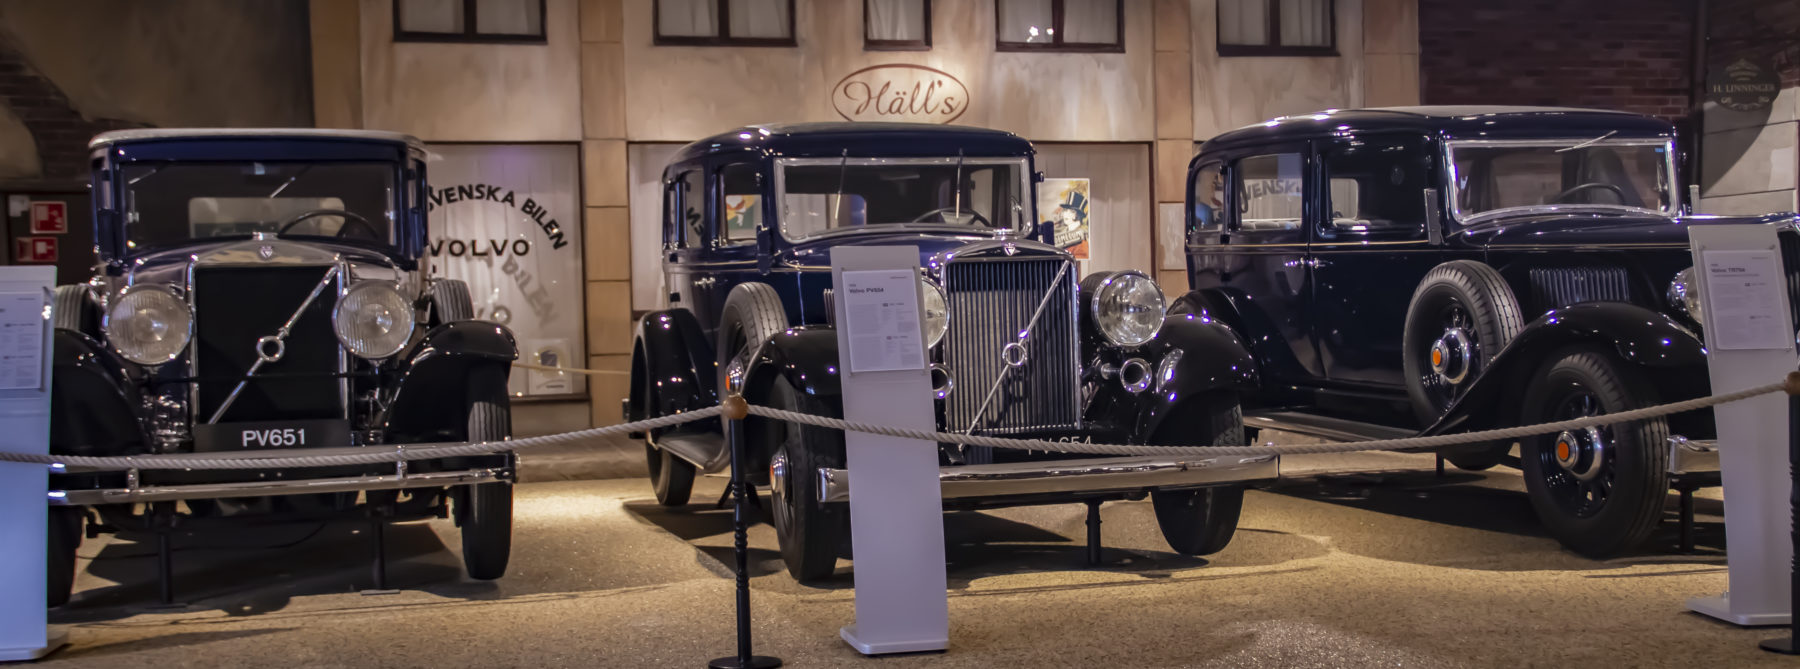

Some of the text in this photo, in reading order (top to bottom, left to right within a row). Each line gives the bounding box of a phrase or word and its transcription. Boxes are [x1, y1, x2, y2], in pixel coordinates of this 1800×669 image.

[843, 79, 961, 116] Häll's
[428, 183, 569, 251] VENSKA BILEN
[430, 238, 530, 258] VOLVO
[242, 428, 305, 447] PV651
